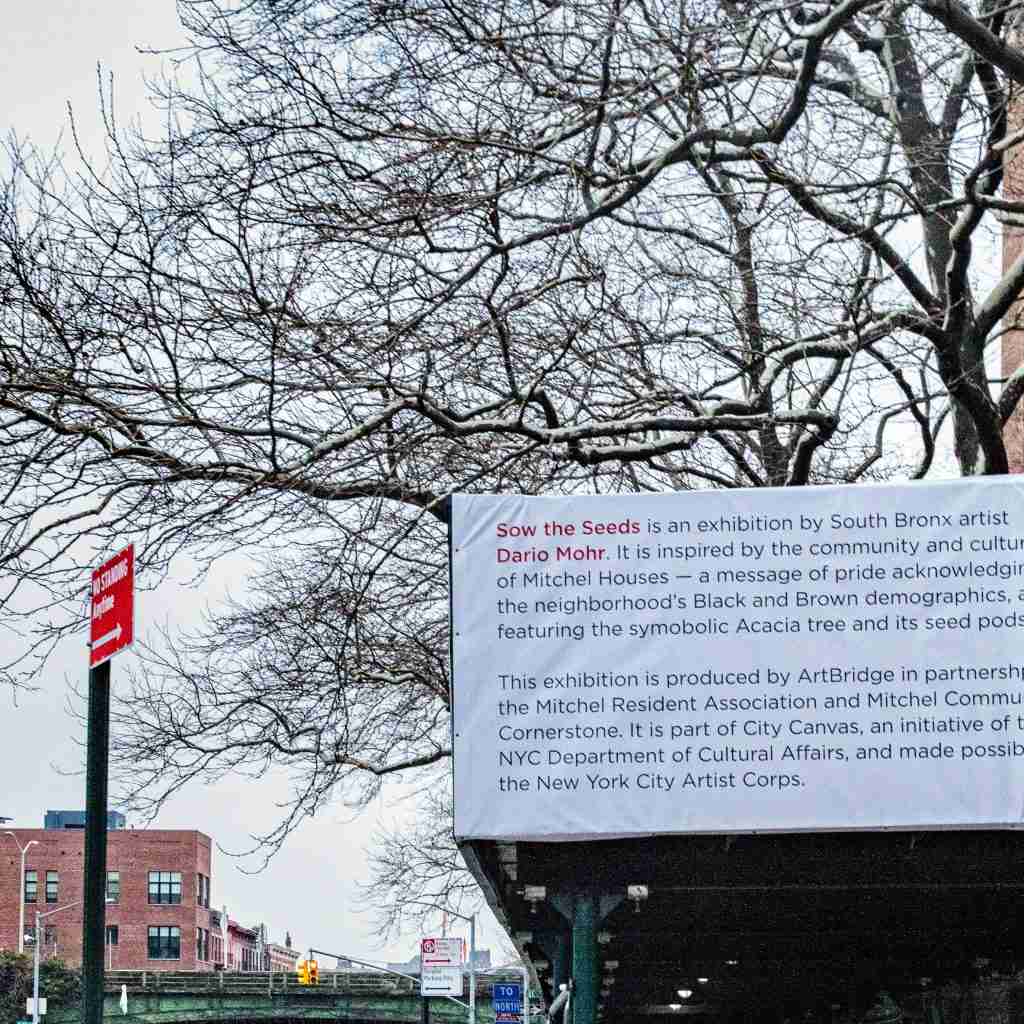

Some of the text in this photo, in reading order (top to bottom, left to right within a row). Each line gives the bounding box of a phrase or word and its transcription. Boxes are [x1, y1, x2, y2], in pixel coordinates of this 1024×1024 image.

[495, 510, 1009, 539] Sow the Seeds is an exhibition by South Bronx artist
[496, 546, 552, 564] Dario
[556, 544, 610, 562] Mohr.
[617, 544, 630, 561] It
[636, 543, 651, 560] is
[657, 541, 735, 561] inspired
[740, 541, 765, 561] by
[771, 540, 803, 557] the
[808, 537, 920, 559] community
[926, 535, 963, 553] and
[496, 571, 518, 589] of
[523, 569, 592, 589] Mitchel
[599, 569, 670, 587] Houses
[698, 571, 710, 584] a
[716, 567, 803, 585] message
[808, 564, 829, 582] of
[833, 563, 887, 585] pride
[496, 597, 529, 615] the
[535, 592, 688, 616] neighborhood's
[693, 591, 747, 609] Black
[752, 591, 789, 609] and
[795, 591, 859, 608] Brown
[864, 586, 1012, 609] demographics,
[497, 621, 585, 641] featuring
[591, 620, 624, 638] the
[628, 617, 729, 639] symobolic
[735, 616, 801, 634] Acacia
[807, 617, 847, 633] tree
[852, 615, 889, 633] and
[895, 615, 919, 631] its
[925, 612, 971, 631] seed
[497, 673, 537, 691] This
[543, 671, 639, 689] exhibition
[645, 670, 660, 687] is
[666, 668, 761, 689] produced
[767, 667, 791, 688] by
[797, 666, 895, 686] ArtBridge
[901, 665, 918, 682] in
[498, 699, 529, 716] the
[536, 695, 605, 715] Mitchel
[612, 695, 697, 713] Resident
[703, 693, 817, 711] Association
[823, 692, 861, 710] and
[867, 690, 937, 709] Mitchel
[498, 723, 623, 741] Cornerstone.
[629, 722, 644, 738] It
[649, 721, 664, 738] is
[670, 721, 712, 741] part
[716, 719, 737, 737] of
[743, 719, 783, 739] City
[788, 719, 864, 736] Canvas,
[869, 720, 894, 735] an
[900, 716, 984, 734] initiative
[990, 714, 1012, 732] of
[499, 749, 541, 767] NYC
[547, 748, 665, 768] Department
[671, 746, 693, 764] of
[698, 743, 774, 763] Cultural
[780, 743, 849, 763] Affairs,
[855, 743, 893, 761] and
[899, 741, 955, 761] made
[499, 771, 806, 792] the New York City Artist Corps.
[500, 986, 513, 996] TO
